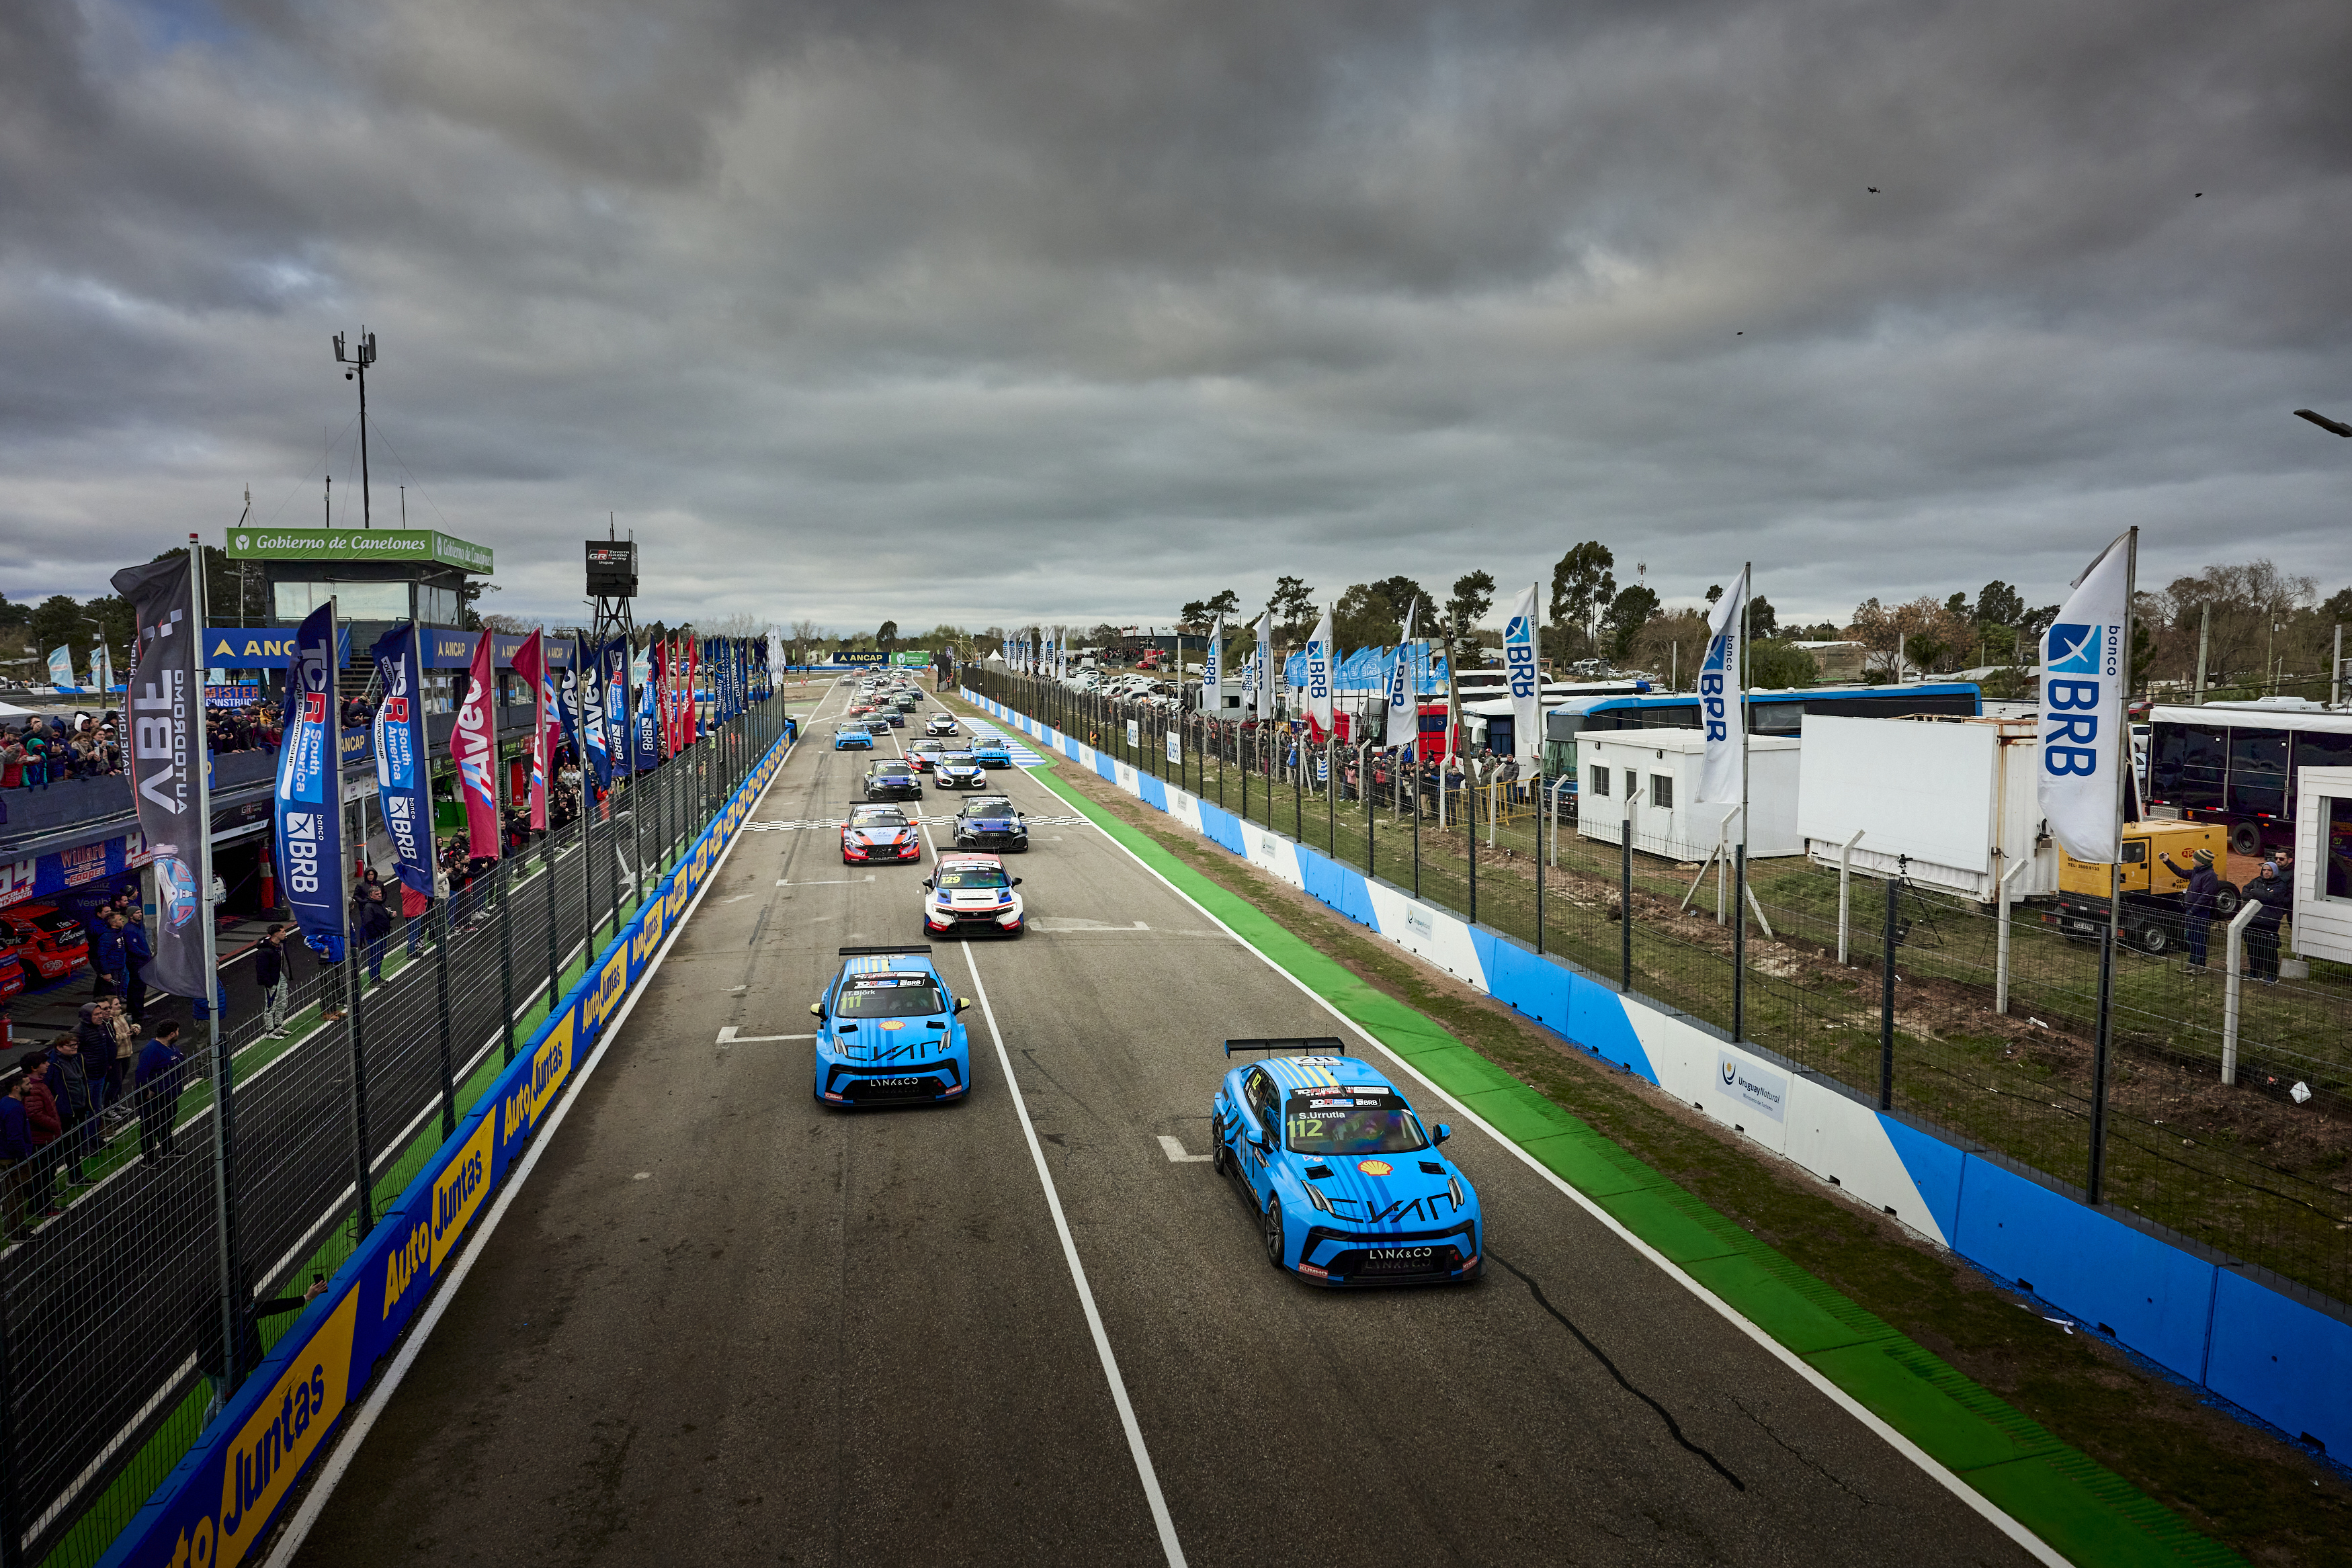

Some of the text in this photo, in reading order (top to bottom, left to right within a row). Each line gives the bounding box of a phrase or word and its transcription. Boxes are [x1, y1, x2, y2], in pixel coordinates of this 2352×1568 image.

[256, 535, 426, 550] Gobierno de Canelones
[444, 539, 492, 567] Gobierno de Canelones
[244, 640, 296, 656] ANC
[445, 642, 465, 657] ANCAP
[552, 647, 563, 658] ANCAP
[1726, 635, 1735, 671] banco
[2107, 625, 2121, 677] banco
[301, 639, 328, 724] TCR
[383, 659, 394, 687] TOURIN
[1204, 657, 1216, 685] BRB
[1310, 661, 1327, 699] BRB
[1505, 646, 1535, 698] BRB
[204, 687, 258, 698] MISTER
[716, 679, 724, 711] Argentina
[289, 701, 303, 767] CHAMPIONSHIP
[642, 729, 654, 750] BRB
[2045, 679, 2099, 777] BRB
[309, 729, 322, 775] South
[341, 735, 365, 752] ANCAP
[388, 726, 401, 781] America
[399, 728, 409, 766] South
[612, 737, 624, 760] BRB
[296, 727, 308, 792] America
[392, 819, 417, 860] BRB
[60, 840, 106, 868] Willard
[78, 862, 92, 873] SPORT
[289, 841, 319, 893] BRB
[941, 876, 961, 884] 129
[840, 995, 862, 1009] 111
[946, 1086, 962, 1094] KUMHO
[1742, 1092, 1757, 1104] Ministerio
[1761, 1102, 1773, 1112] Turismo
[1287, 1119, 1323, 1138] 112
[1298, 1111, 1345, 1120] S.Urrutia
[1299, 1265, 1328, 1276] KUMHO
[1462, 1256, 1478, 1270] KUMHO
